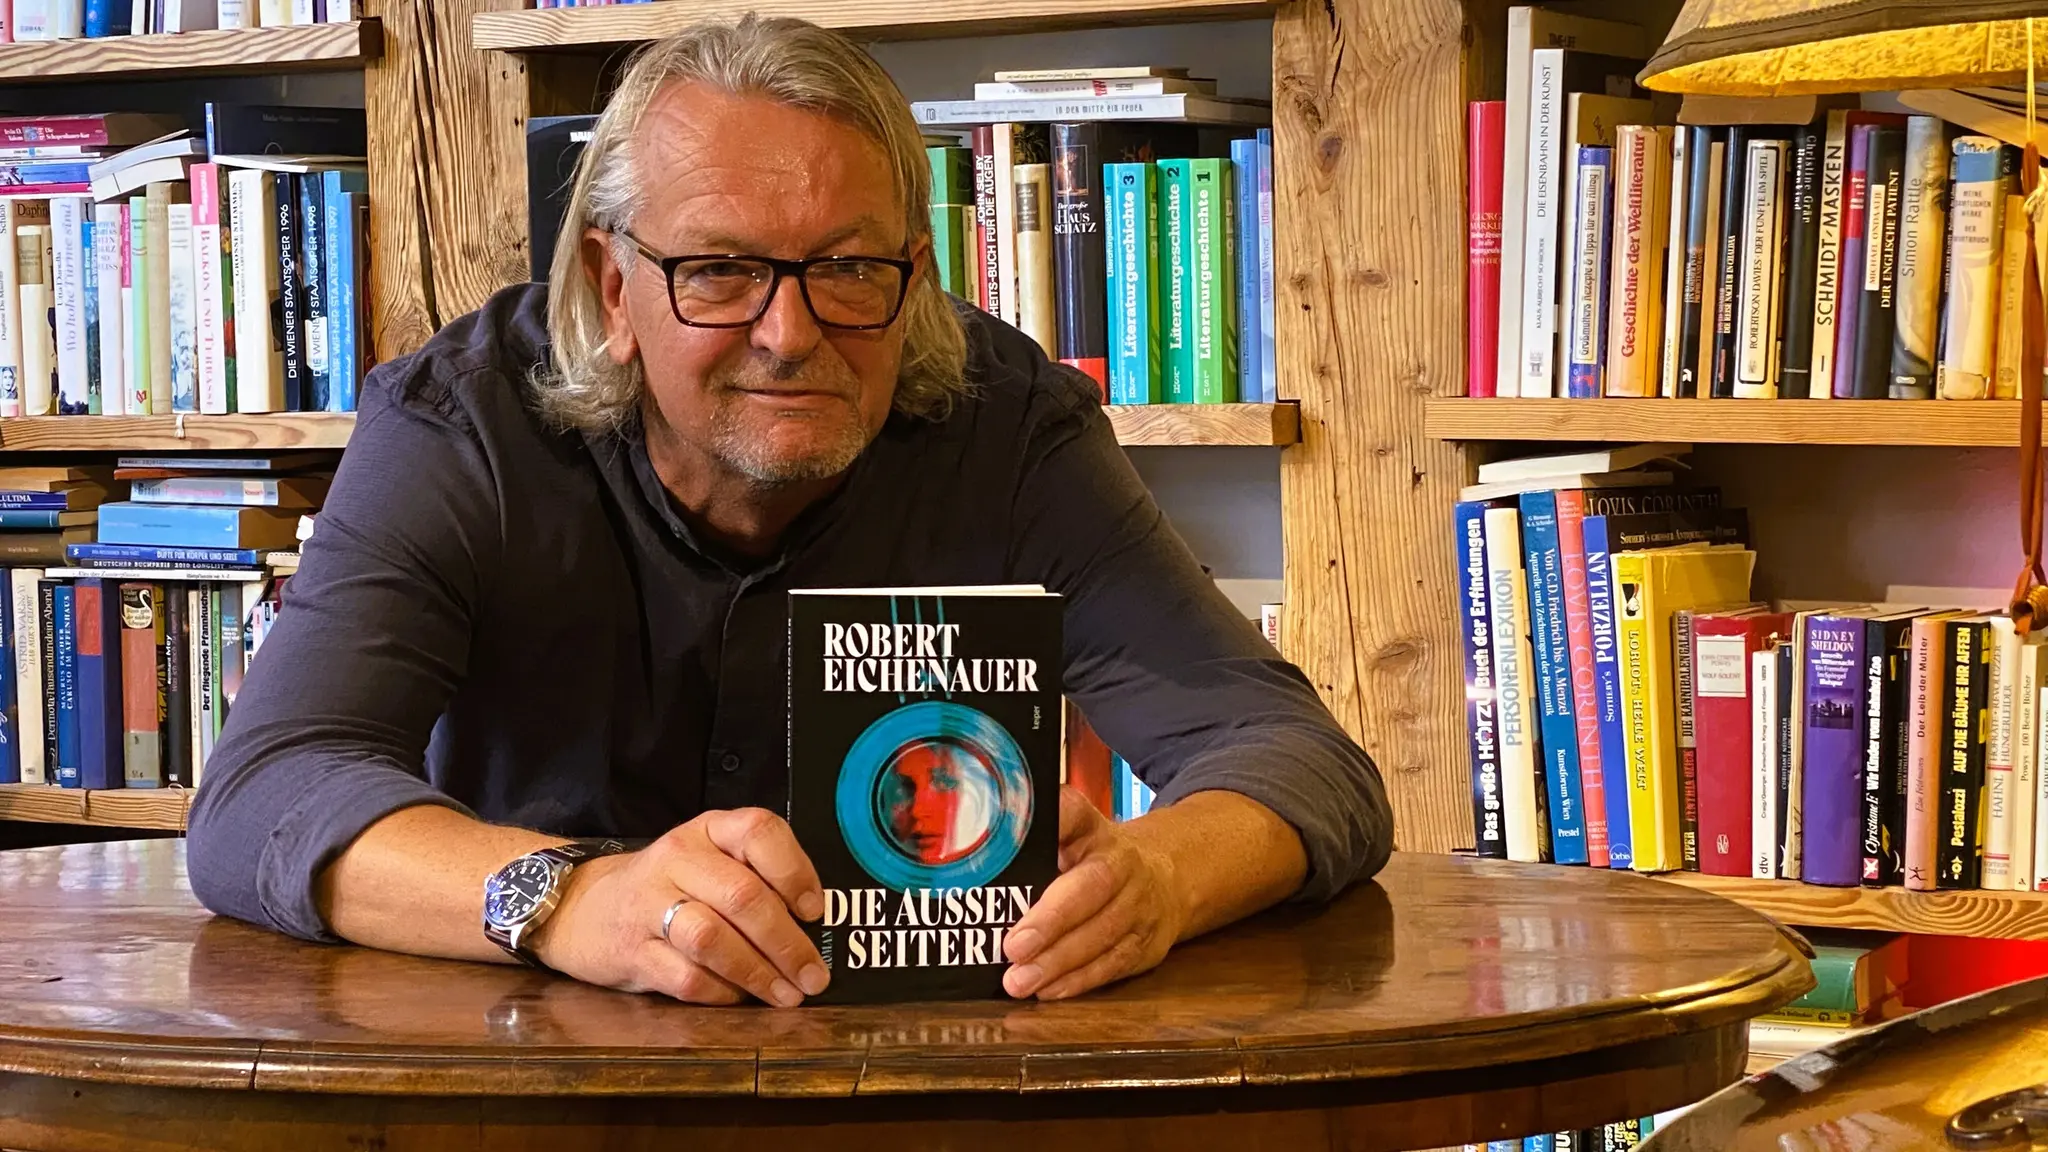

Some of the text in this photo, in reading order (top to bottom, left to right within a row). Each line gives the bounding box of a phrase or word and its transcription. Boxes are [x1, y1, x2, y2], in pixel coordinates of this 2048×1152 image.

[1537, 64, 1551, 218] DIE EISENBAHN IN DER KUNST
[1804, 135, 1817, 190] Christine
[975, 154, 986, 226] JOHN SELBY
[1586, 174, 1599, 198] Alltag
[1586, 201, 1596, 217] den
[62, 204, 73, 236] sind
[984, 154, 999, 318] HEITS-BUCH FÜR DIE AUGEN
[1054, 222, 1097, 235] SCHATZ
[1057, 209, 1090, 224] HAUS
[1585, 219, 1596, 231] für
[1881, 169, 1899, 308] DER ENGLISCHE PATIENT
[1902, 178, 1921, 278] Simon Rattle
[200, 230, 211, 291] BALKON
[1121, 175, 1138, 357] Literaturgeschichte 3
[1167, 167, 1183, 349] Literaturgeschichte 2
[1197, 172, 1213, 360] Literaturgeschichte 1
[1583, 233, 1597, 256] Tipps
[1620, 134, 1646, 358] Geschichte der Weltliteratur
[1749, 154, 1768, 349] ROBERTSON DAVIES DER FÜNFTE IM SPIEL
[1868, 242, 1878, 285] MICHAEL
[280, 204, 297, 379] DIE WIENER STAATSOPER 1996
[307, 205, 322, 377] DIE WIENER STAATSOPER 1998
[328, 205, 341, 377] DIE WIENER STAATSOPER 1997
[1261, 238, 1271, 304] Monika Werner
[65, 292, 76, 325] hohe
[66, 329, 77, 351] Wo
[204, 335, 214, 407] TERRASSE
[1467, 519, 1485, 617] Erfindungen
[43, 588, 53, 620] Abend
[1543, 547, 1557, 571] Von
[1552, 648, 1565, 664] bis
[1586, 552, 1613, 663] PORZELLAN
[19, 635, 29, 679] ASTRID
[64, 594, 74, 710] CARUSO IM AFFENHAUS
[200, 584, 211, 711] Der fliegende Pfannkuchen
[822, 622, 960, 659] ROBERT
[1473, 620, 1488, 647] der
[1528, 550, 1555, 716] Aquarelle und Zeichnungen der Romantik
[1811, 630, 1856, 641] SIDNEY
[1811, 640, 1854, 652] SHELDON
[44, 621, 55, 697] Tausendundein
[822, 658, 1040, 693] EICHENAUER
[1474, 649, 1490, 688] Buch
[1494, 568, 1523, 747] PERSONENLEXIKON
[1563, 554, 1602, 790] LOVIS CORINTH
[1677, 615, 1692, 717] KANNIBALENGALAXIS
[1868, 655, 1881, 675] Zoo
[1867, 675, 1881, 717] Bahnhof
[1917, 637, 1928, 738] Der Leib der Mutter
[1632, 699, 1645, 744] HEILE
[1682, 719, 1694, 737] DIE
[1869, 718, 1880, 740] vom
[1951, 627, 1970, 847] Pestalozzi AUF DIE BÄUME IHR AFFEN
[2000, 684, 2013, 763] HUNGERLEIDER
[2020, 674, 2031, 782] Powys 100 Beste Bücher
[1635, 748, 1648, 790] WELT
[1866, 741, 1879, 772] Kinder
[1480, 762, 1499, 810] große
[1556, 748, 1571, 820] Kunstforum Wien
[1866, 772, 1879, 790] Wir
[1992, 774, 2004, 819] HAHNL
[1482, 812, 1497, 840] Das
[1558, 828, 1580, 838] Prestel
[1683, 831, 1696, 862] PIPER
[1865, 803, 1880, 855] Christiane
[1759, 856, 1768, 874] dtv
[822, 885, 1033, 927] DIE AUSSEN
[847, 927, 1012, 969] SEITERI
